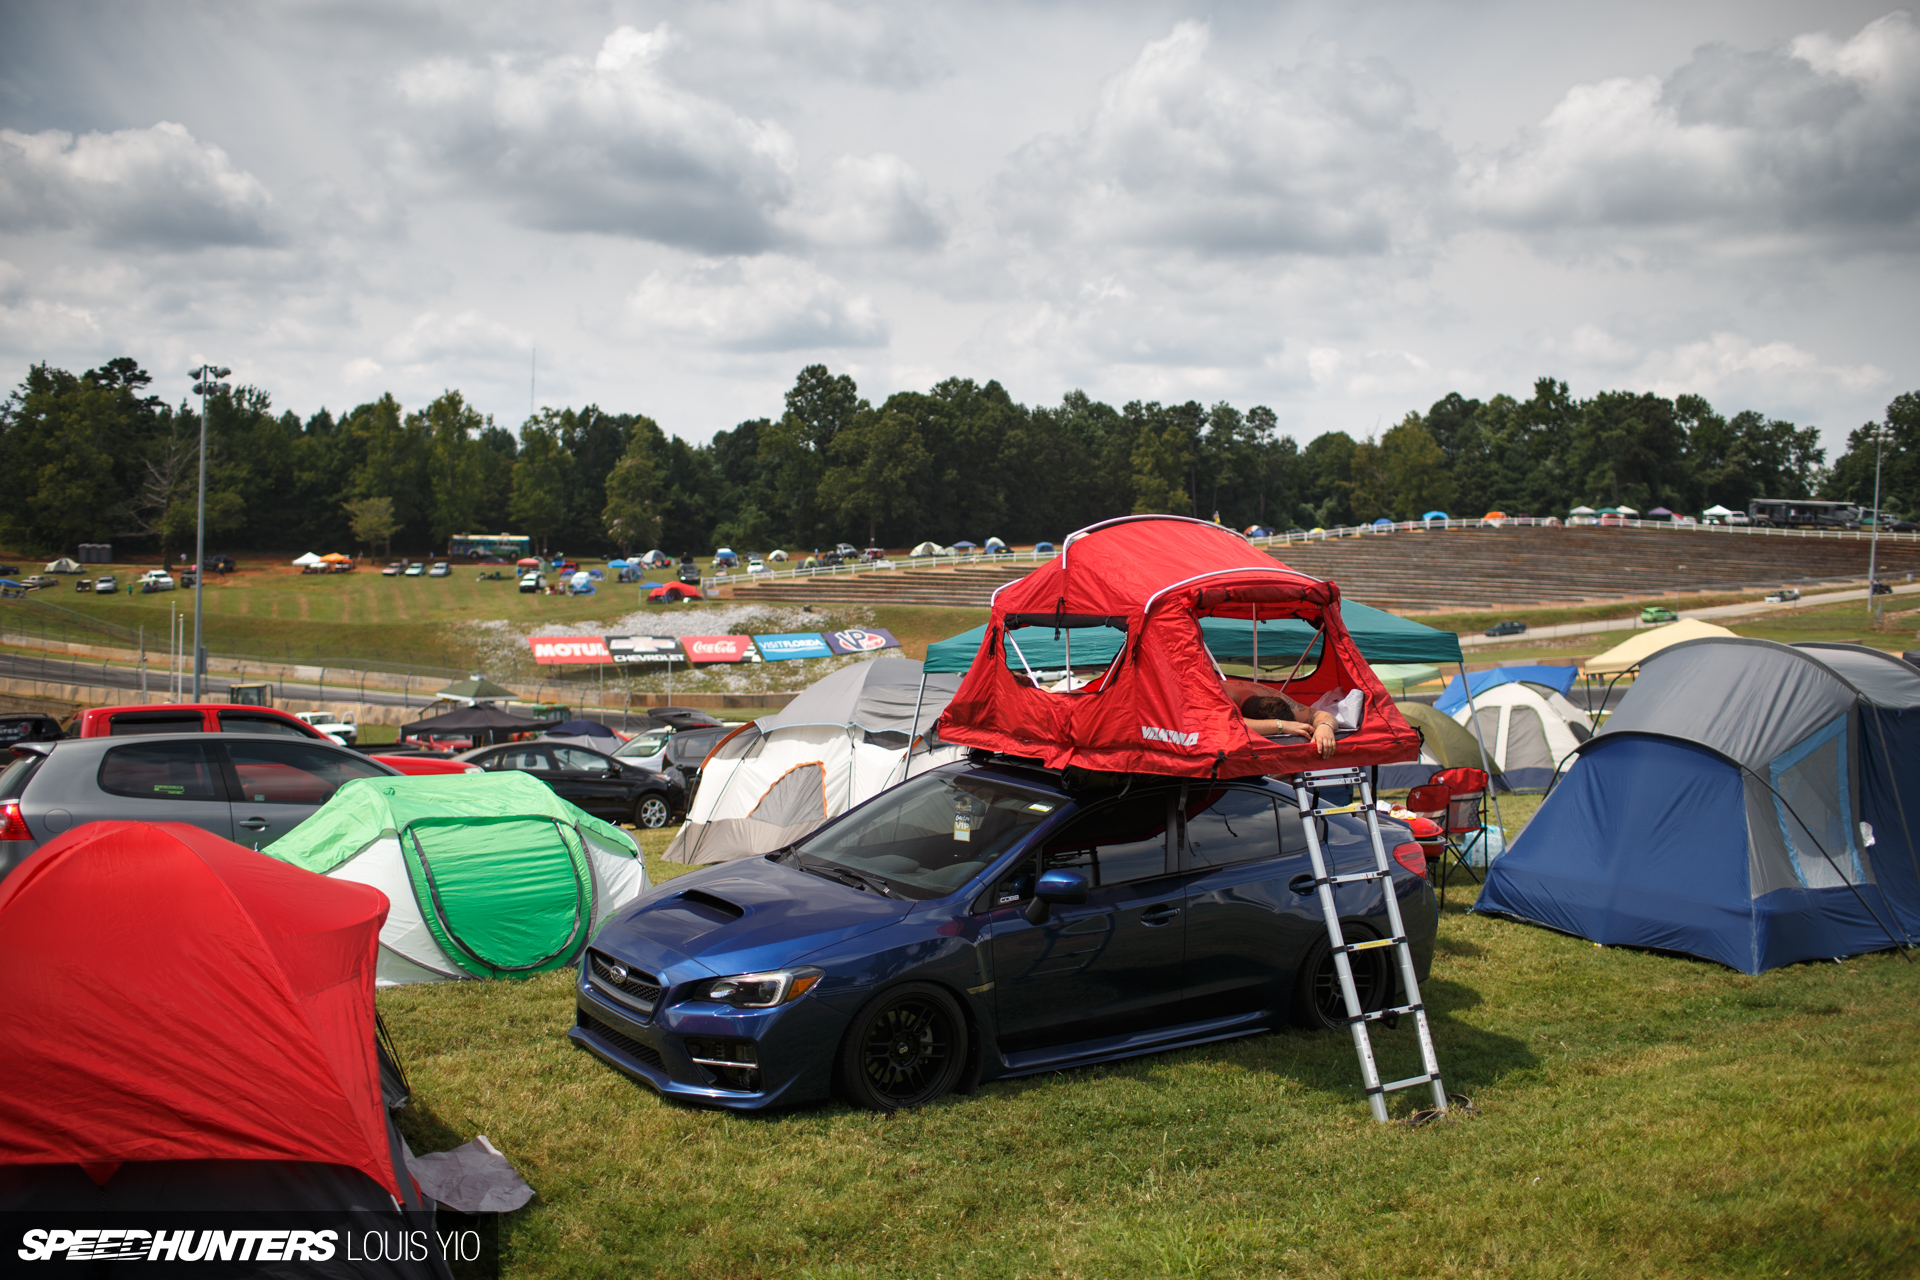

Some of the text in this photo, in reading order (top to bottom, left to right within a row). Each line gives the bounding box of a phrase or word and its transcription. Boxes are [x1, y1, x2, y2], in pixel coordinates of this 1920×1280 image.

[834, 629, 867, 650] VP
[534, 642, 609, 657] MOTUL
[613, 654, 685, 662] CHEVROLET
[1141, 726, 1199, 746] YAKIMA
[955, 821, 970, 830] VIP
